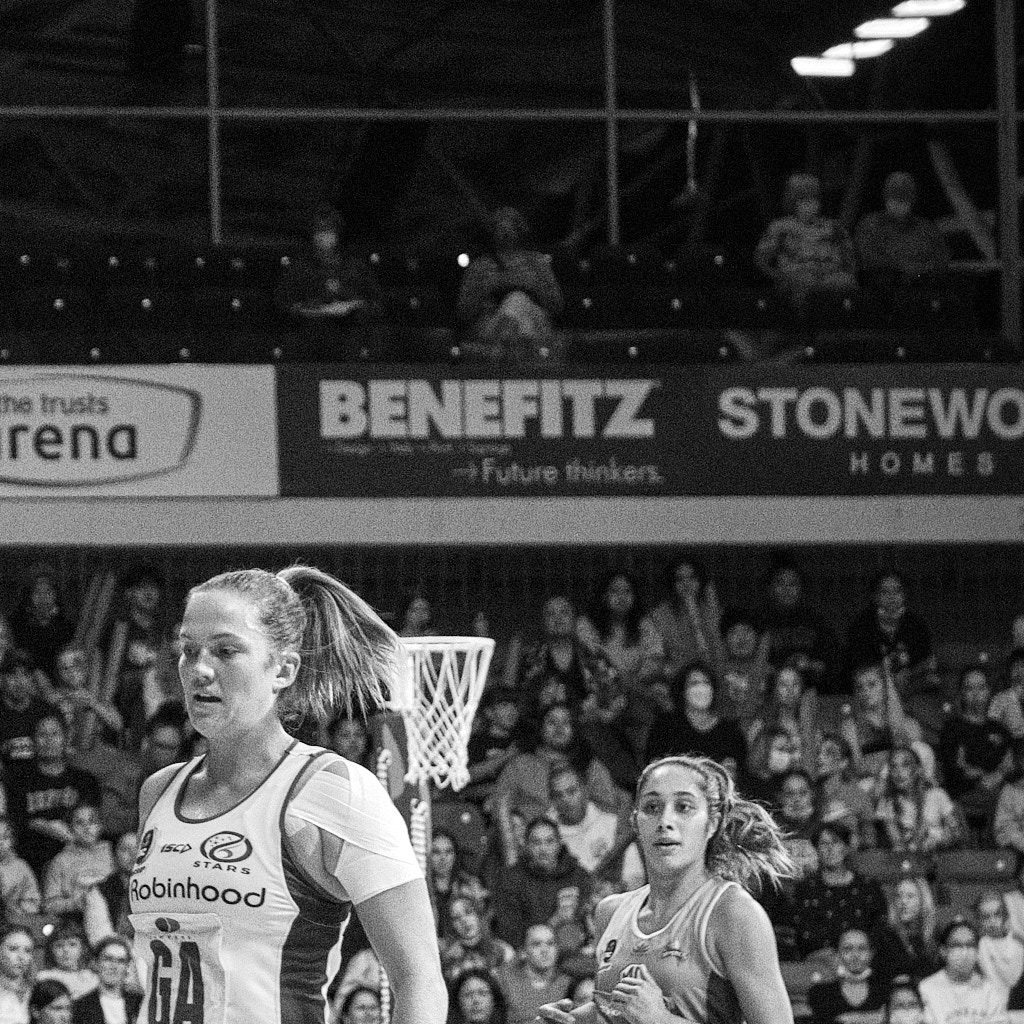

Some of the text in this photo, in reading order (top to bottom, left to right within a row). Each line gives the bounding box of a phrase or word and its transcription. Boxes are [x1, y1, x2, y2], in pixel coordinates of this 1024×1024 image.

[41, 393, 109, 416] trusts
[319, 379, 661, 439] BENEFITZ
[482, 457, 558, 485] Future
[850, 452, 995, 475] HOMES
[192, 860, 251, 875] STARS
[130, 876, 266, 908] Robinhood
